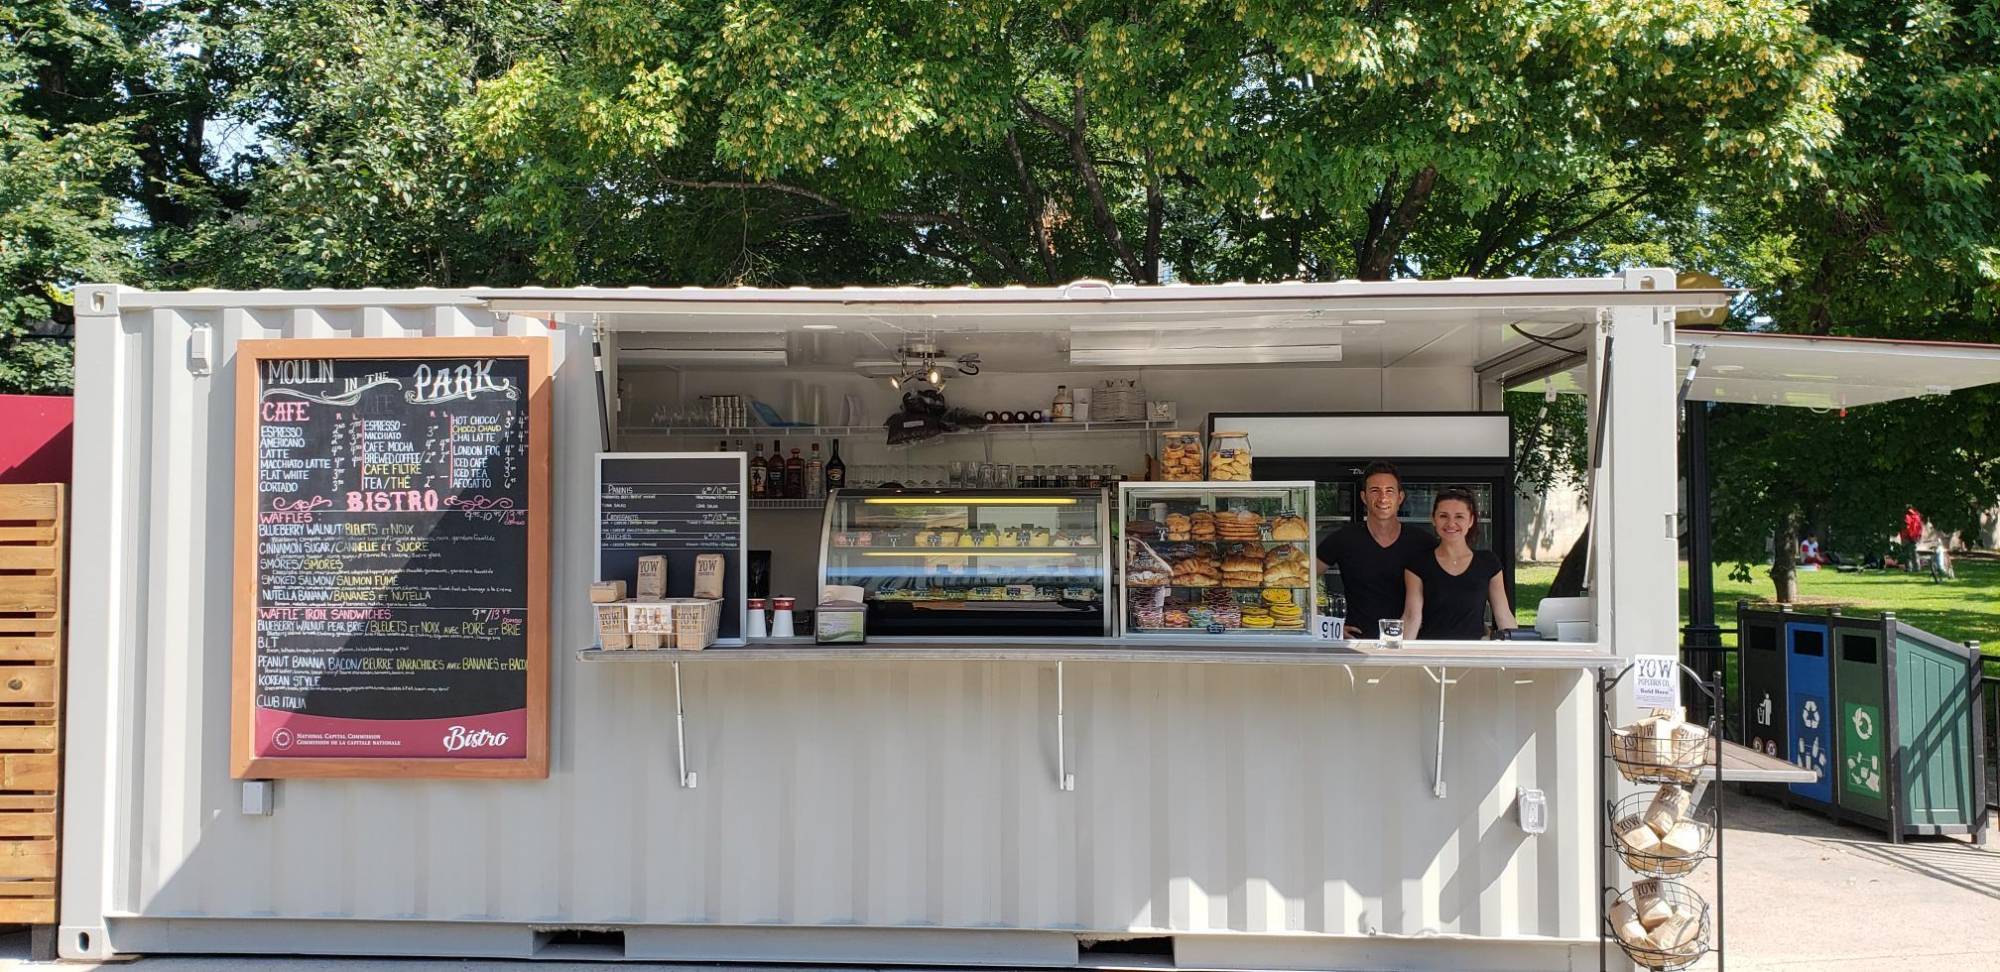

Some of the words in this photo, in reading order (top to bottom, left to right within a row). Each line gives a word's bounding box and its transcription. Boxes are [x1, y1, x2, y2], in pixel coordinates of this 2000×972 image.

[268, 359, 334, 385] MOULIN
[345, 378, 358, 394] IN
[365, 372, 389, 385] THE
[413, 359, 495, 400] PARK
[262, 401, 310, 422] CAFE
[261, 425, 303, 438] ESPRESSO
[365, 420, 400, 431] ESPRESSO
[365, 431, 401, 440] MACCHIATO
[453, 432, 469, 442] CHAI
[472, 432, 496, 442] LATTE
[260, 437, 305, 448] AMERICANO
[364, 441, 385, 452] CAFE
[388, 441, 414, 452] MOCHA
[260, 448, 290, 459] LATTE
[453, 445, 482, 455] LONDON
[485, 445, 501, 456] FOG
[261, 459, 303, 469] MACCHIATO
[306, 459, 331, 469] LATTE
[365, 452, 394, 464] BREWED
[454, 458, 468, 468] ICED
[470, 456, 488, 468] CAFÉ
[261, 470, 281, 480] FLAT
[283, 470, 310, 480] WHITE
[364, 463, 390, 475] CAFE
[392, 463, 422, 475] FILTRE
[454, 469, 469, 478] ICED
[472, 469, 488, 478] TEA
[260, 482, 298, 492] CORTADO
[453, 478, 491, 488] AFOGATTO
[346, 490, 438, 512] BISTRO
[260, 513, 313, 524] WAFFLES
[259, 523, 304, 536] BLUEBERRY
[391, 523, 414, 536] NOIX
[260, 542, 303, 554] CINNAMON
[381, 543, 391, 552] ET
[396, 541, 429, 552] SUCRE
[640, 560, 659, 573] YOW
[698, 559, 716, 572] YOW
[262, 576, 297, 586] SMOKED
[375, 575, 399, 586] FUMÉ
[264, 590, 297, 601] NUTELLA
[392, 590, 431, 601] NUTELLA
[258, 620, 295, 633] BLUEBERRY
[297, 621, 325, 632] WALNUT
[328, 621, 345, 632] PEAR
[410, 626, 421, 634] ET
[421, 621, 440, 633] NOIX
[463, 621, 485, 635] POIRE
[488, 627, 499, 636] ET
[502, 623, 521, 637] BRIE
[1321, 622, 1341, 639] 910
[258, 656, 289, 668] PEANUT
[292, 656, 326, 670] BANANA
[463, 657, 499, 671] BANANES
[1638, 658, 1673, 679] YOW
[259, 676, 290, 687] KOREAN
[293, 676, 321, 688] STYLE
[257, 695, 279, 709] CLUB
[283, 697, 307, 710] ITALIA
[443, 726, 509, 752] Bistro
[1617, 814, 1640, 831] YOW
[1636, 882, 1657, 897] YOW
